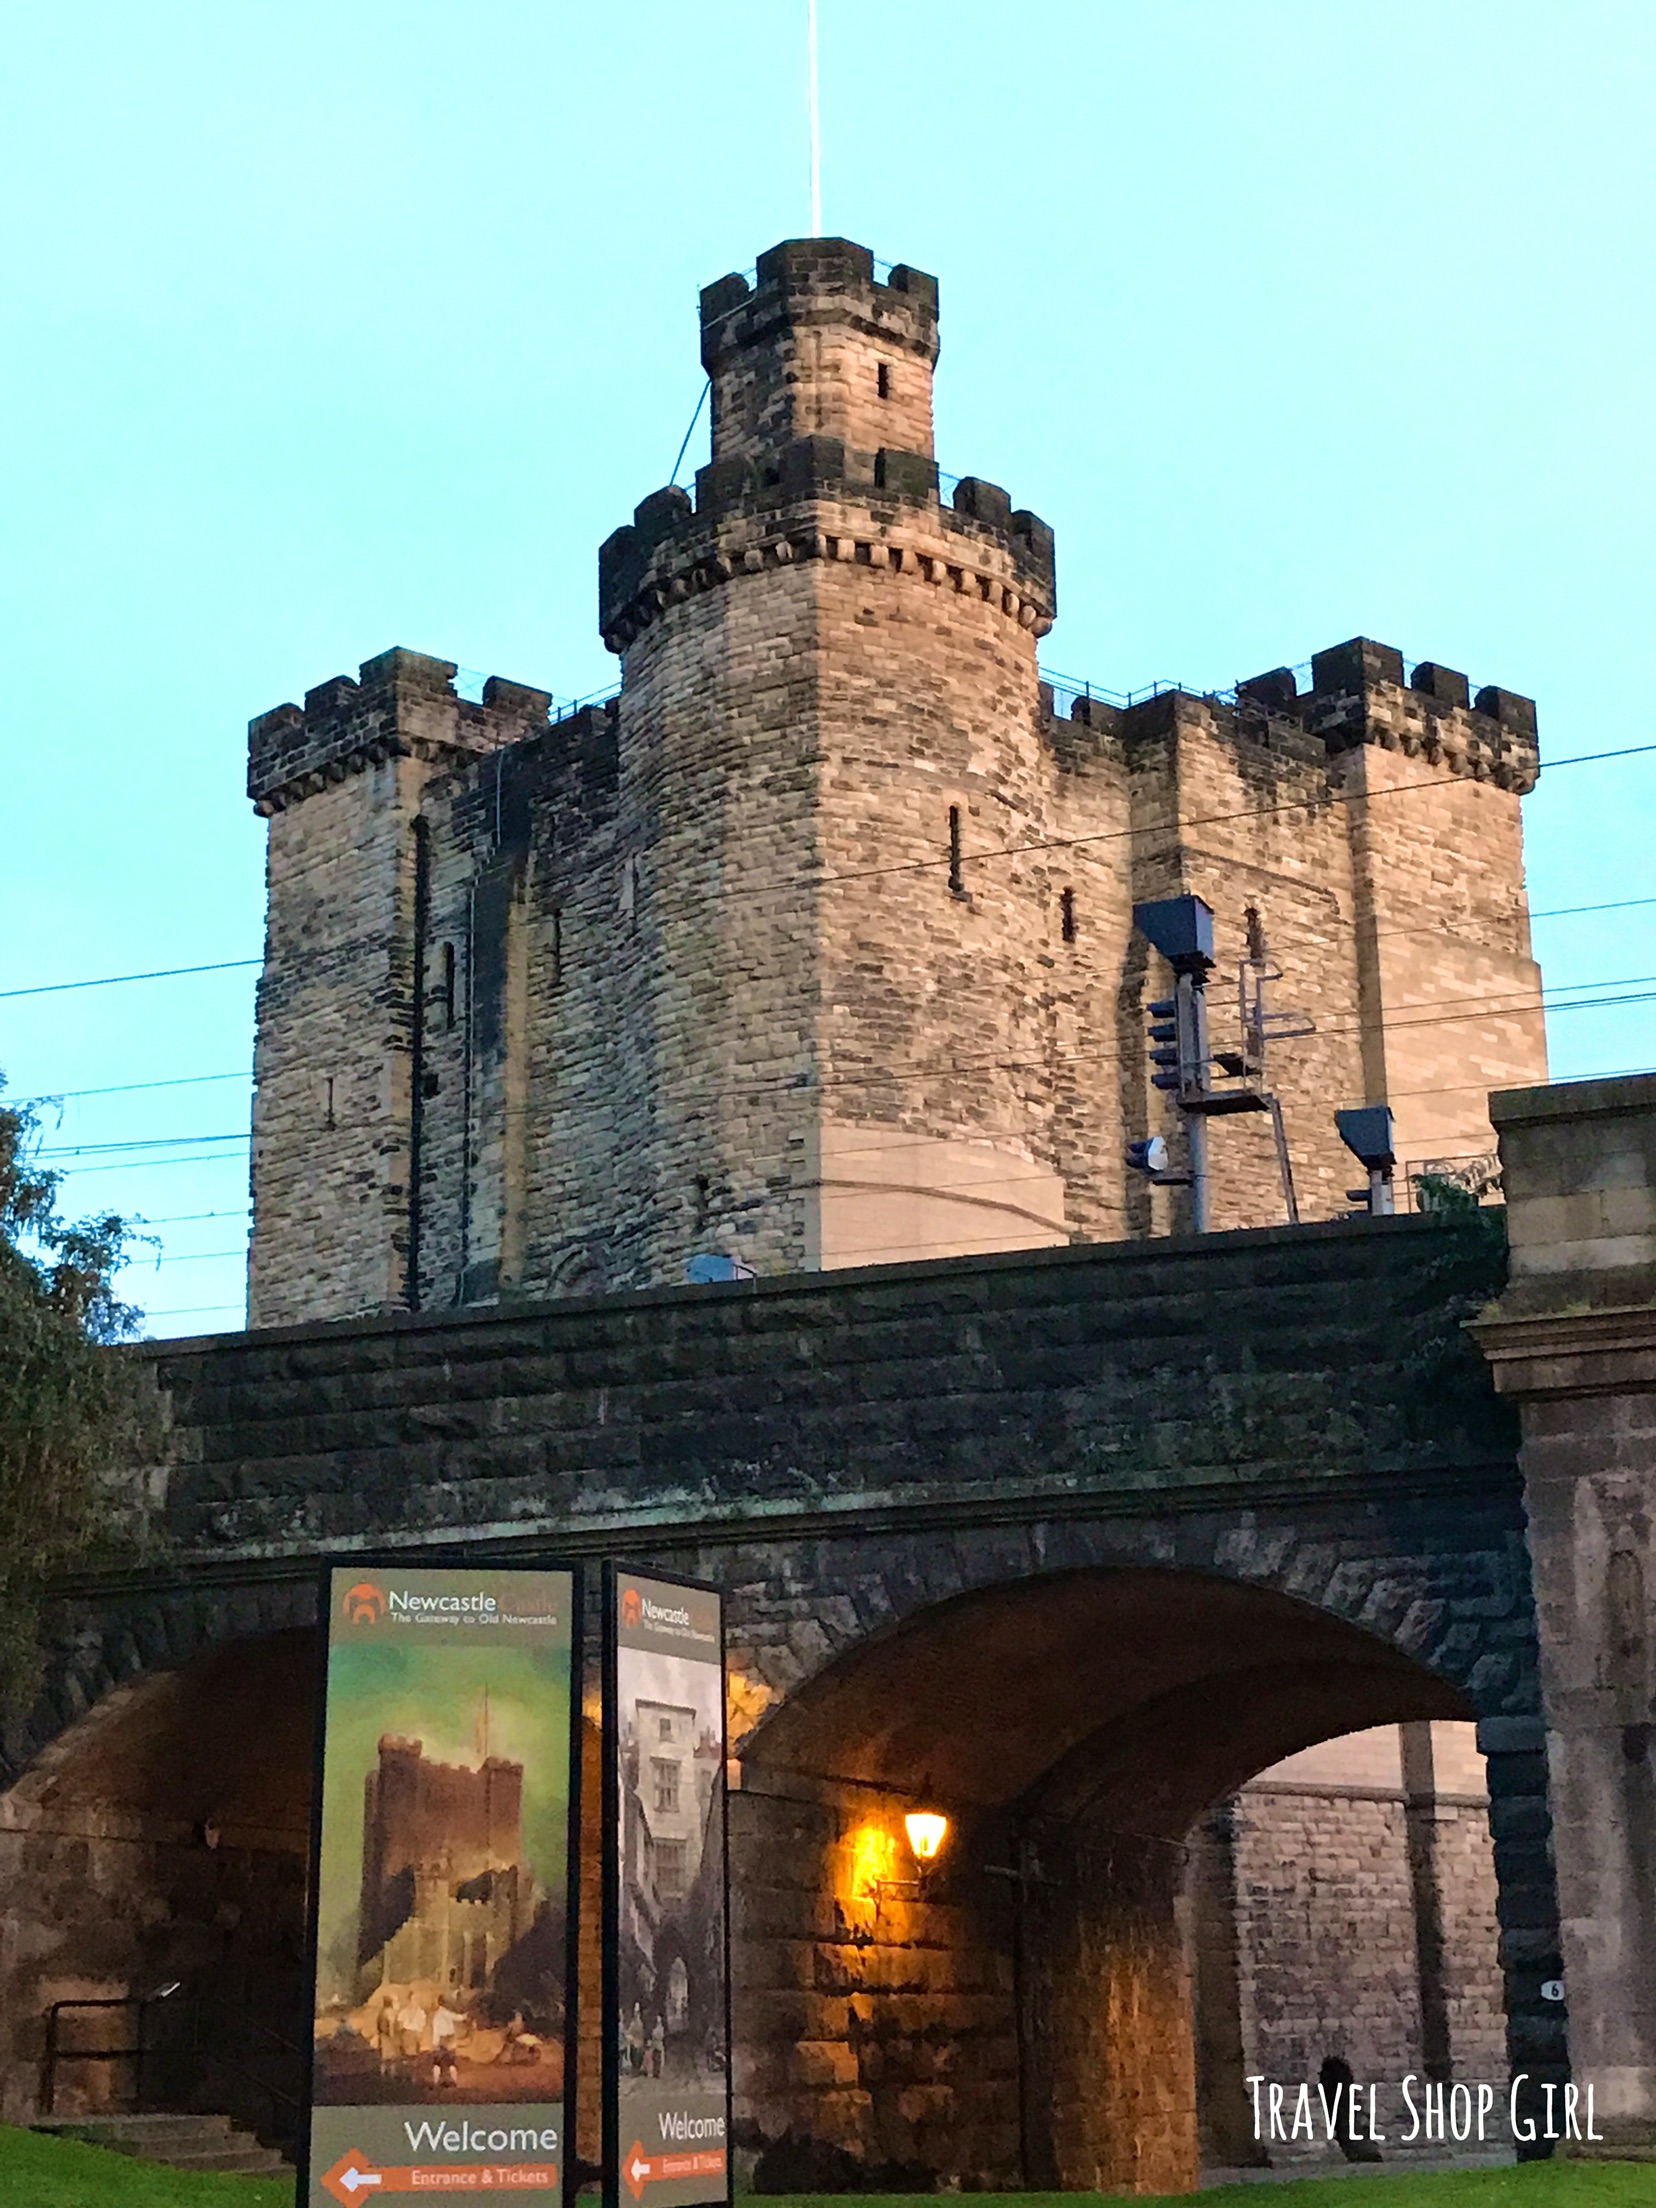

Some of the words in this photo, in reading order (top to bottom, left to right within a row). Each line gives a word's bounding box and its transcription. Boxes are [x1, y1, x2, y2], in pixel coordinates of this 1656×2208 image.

[389, 1590, 496, 1611] Newcastle
[391, 1613, 411, 1623] The
[415, 1613, 461, 1625] Gateway
[463, 1615, 475, 1624] to
[479, 1613, 498, 1624] Old
[502, 1614, 557, 1625] Newcastle
[642, 1598, 689, 1626] Newcastle
[1551, 1983, 1559, 1998] 6
[404, 2120, 558, 2151] Welcome
[659, 2111, 725, 2140] Welcome
[411, 2170, 477, 2185] Entrance
[481, 2169, 493, 2184] &
[496, 2168, 548, 2184] Tickets
